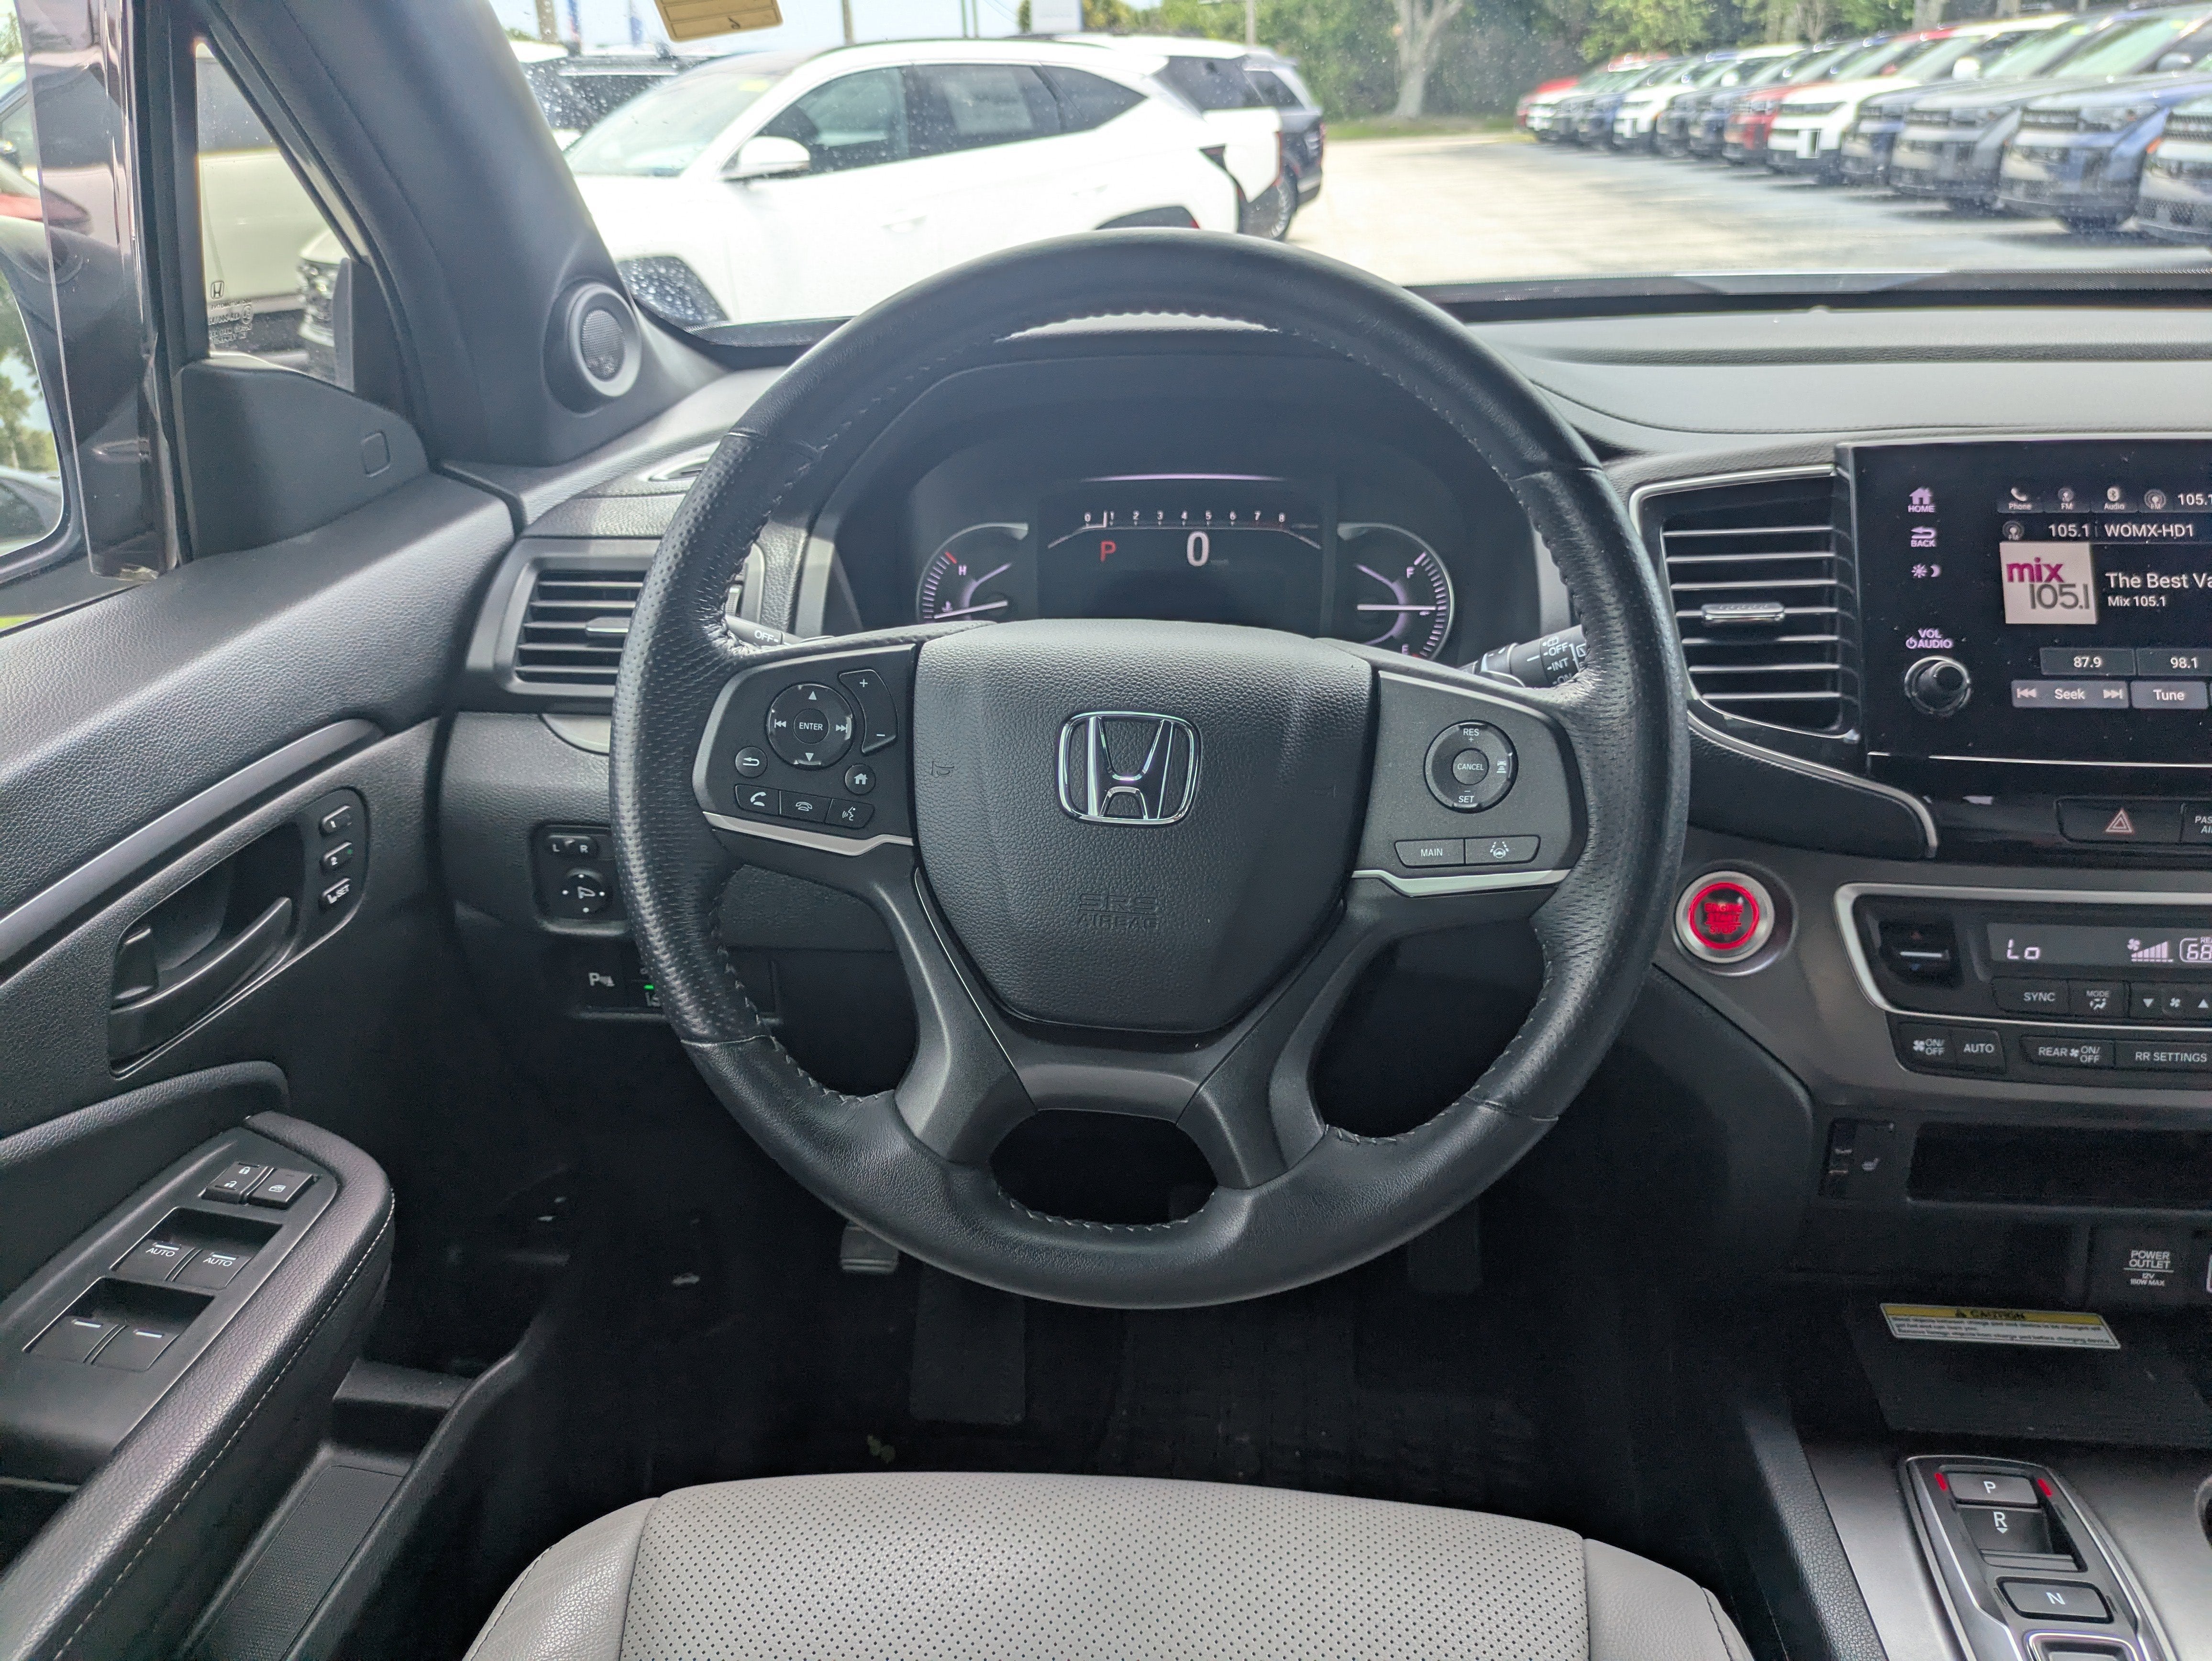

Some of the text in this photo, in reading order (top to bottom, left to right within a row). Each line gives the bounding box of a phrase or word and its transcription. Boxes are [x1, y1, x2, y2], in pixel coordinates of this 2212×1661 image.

[1908, 505, 1935, 513] HOME
[1084, 511, 1285, 522] 0 1 2 3 4 5 6 7 8
[2049, 524, 2090, 537] 105.1
[2105, 524, 2193, 538] WOMX-HD1
[1101, 531, 1209, 566] P 0
[958, 565, 967, 576] H
[1406, 566, 1415, 578] F
[2006, 556, 2064, 584] mix
[2105, 573, 2141, 588] The
[2147, 573, 2189, 589] Best
[2029, 583, 2090, 610] 105.1
[2108, 596, 2166, 607] Mix 105.1
[754, 630, 774, 642] OFF
[1918, 628, 1942, 638] VOL
[1917, 638, 1953, 648] AUDIO
[1548, 642, 1568, 656] OFF
[1551, 657, 1568, 671] INT
[2073, 656, 2102, 668] 87.9
[2170, 656, 2199, 669] 98.1
[2055, 688, 2086, 700] Seek
[2153, 689, 2185, 701] Tune
[799, 722, 823, 731] ENTER
[1463, 728, 1479, 737] RES
[1457, 763, 1484, 771] CANCEL
[1458, 795, 1475, 804] SET
[552, 844, 560, 853] L
[579, 845, 588, 853] R
[1421, 848, 1443, 857] MAIN
[2024, 991, 2056, 1002] SYNC
[2086, 990, 2110, 998] MODE
[1925, 1047, 1945, 1056] OFF
[1964, 1043, 1994, 1053] AUTO
[2039, 1047, 2067, 1057] REAR
[2080, 1054, 2100, 1063] OFF
[2135, 1052, 2207, 1063] RR SETTINGS
[145, 1247, 175, 1257] AUTO
[2131, 1250, 2170, 1260] POWER
[203, 1257, 232, 1267] AUTO
[2129, 1259, 2171, 1269] OUTLET
[1983, 1480, 1996, 1494] P
[1994, 1511, 2007, 1528] R
[2046, 1592, 2066, 1606] N
